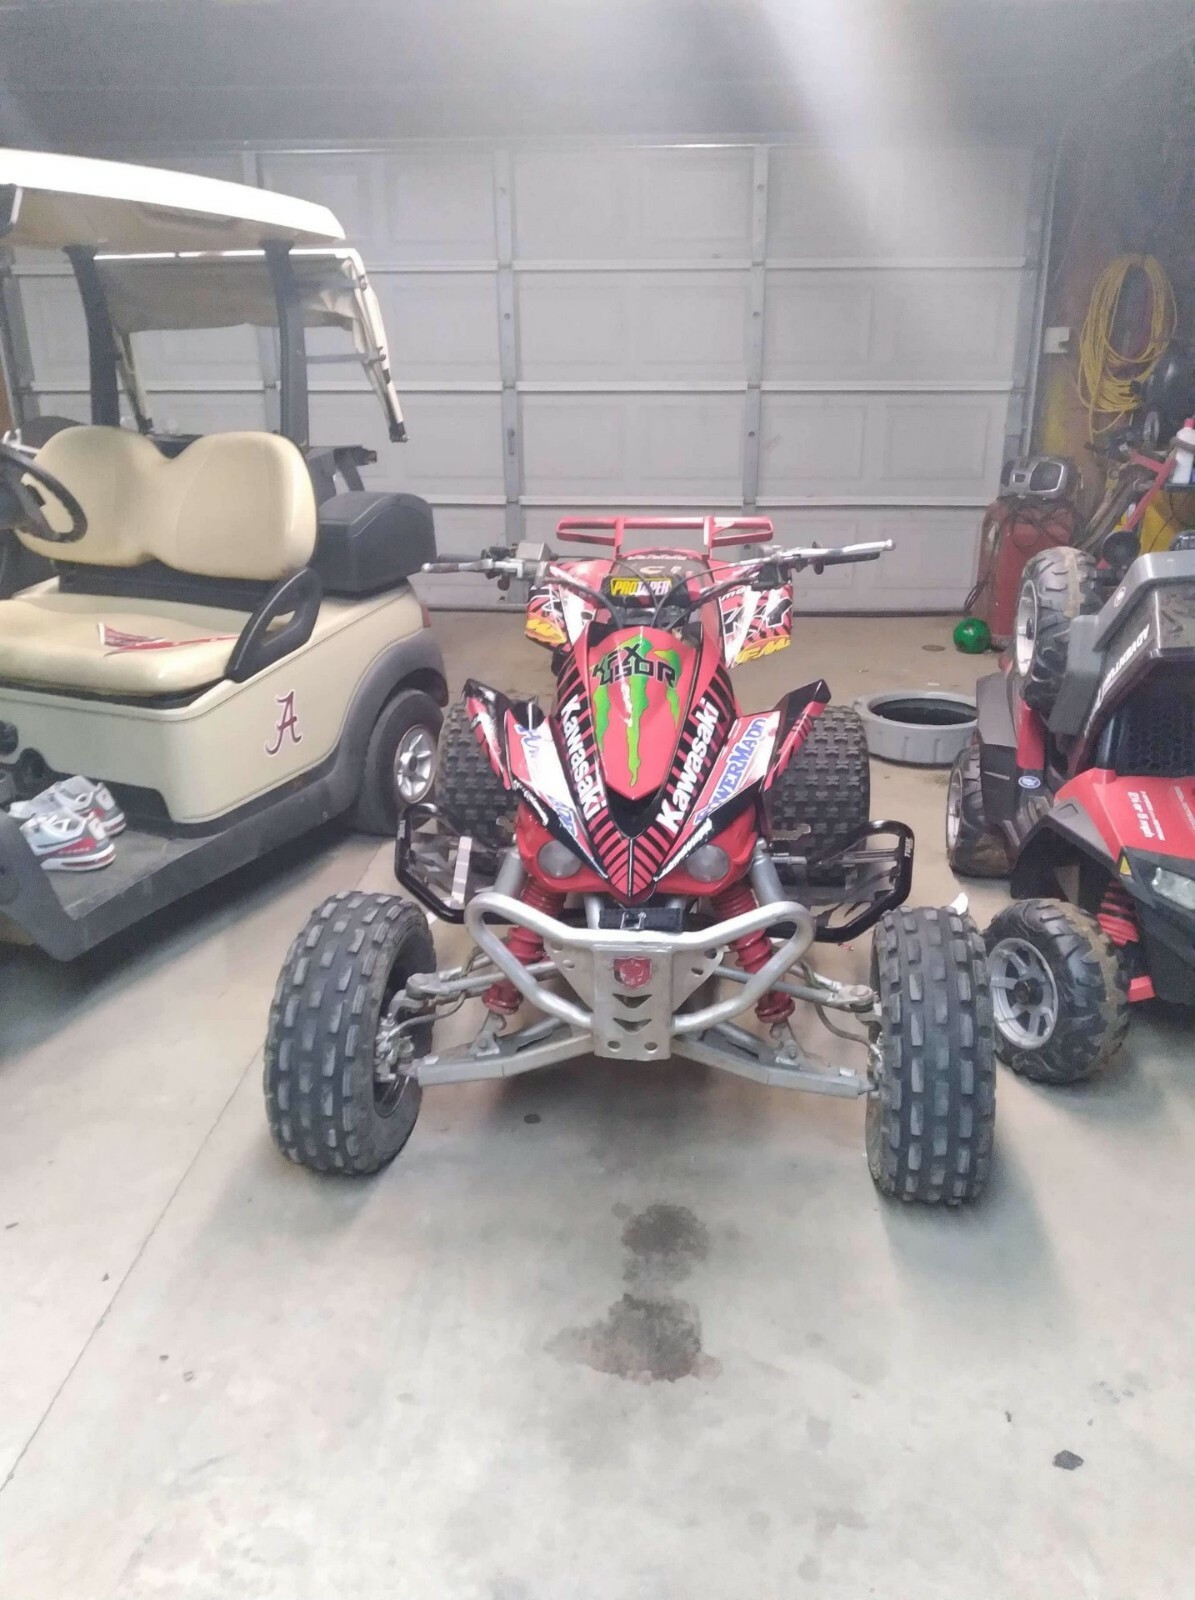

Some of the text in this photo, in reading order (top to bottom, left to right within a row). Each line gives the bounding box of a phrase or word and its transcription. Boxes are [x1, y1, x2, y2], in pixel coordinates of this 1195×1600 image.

[265, 689, 303, 756] A
[560, 693, 608, 822] Kawasaki
[655, 696, 720, 834] Kawasaki
